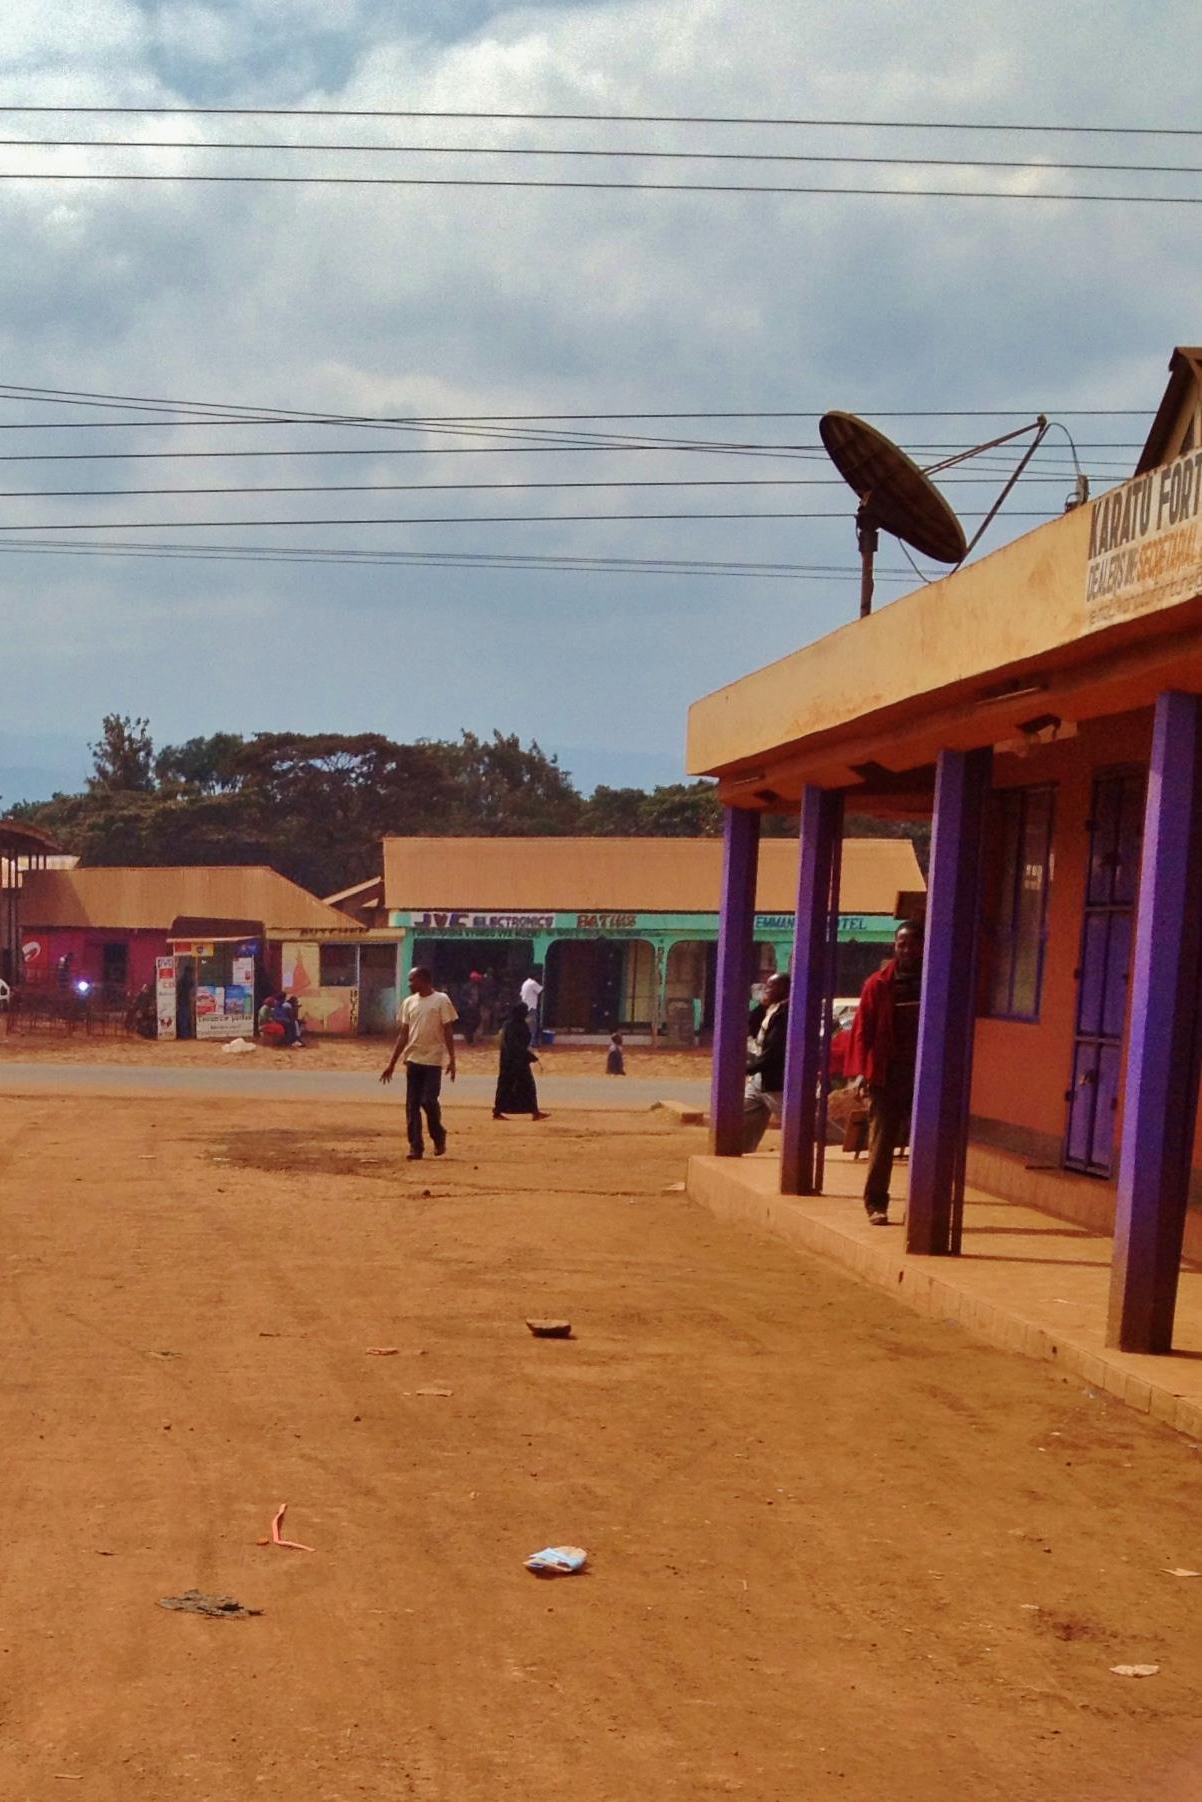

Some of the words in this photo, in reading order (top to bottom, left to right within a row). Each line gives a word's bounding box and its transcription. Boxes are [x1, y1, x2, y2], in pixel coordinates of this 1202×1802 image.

[1088, 474, 1153, 562] KARATU
[473, 916, 554, 928] ELECTRONICS
[755, 916, 796, 930] EMMAN
[837, 917, 867, 930] TEL
